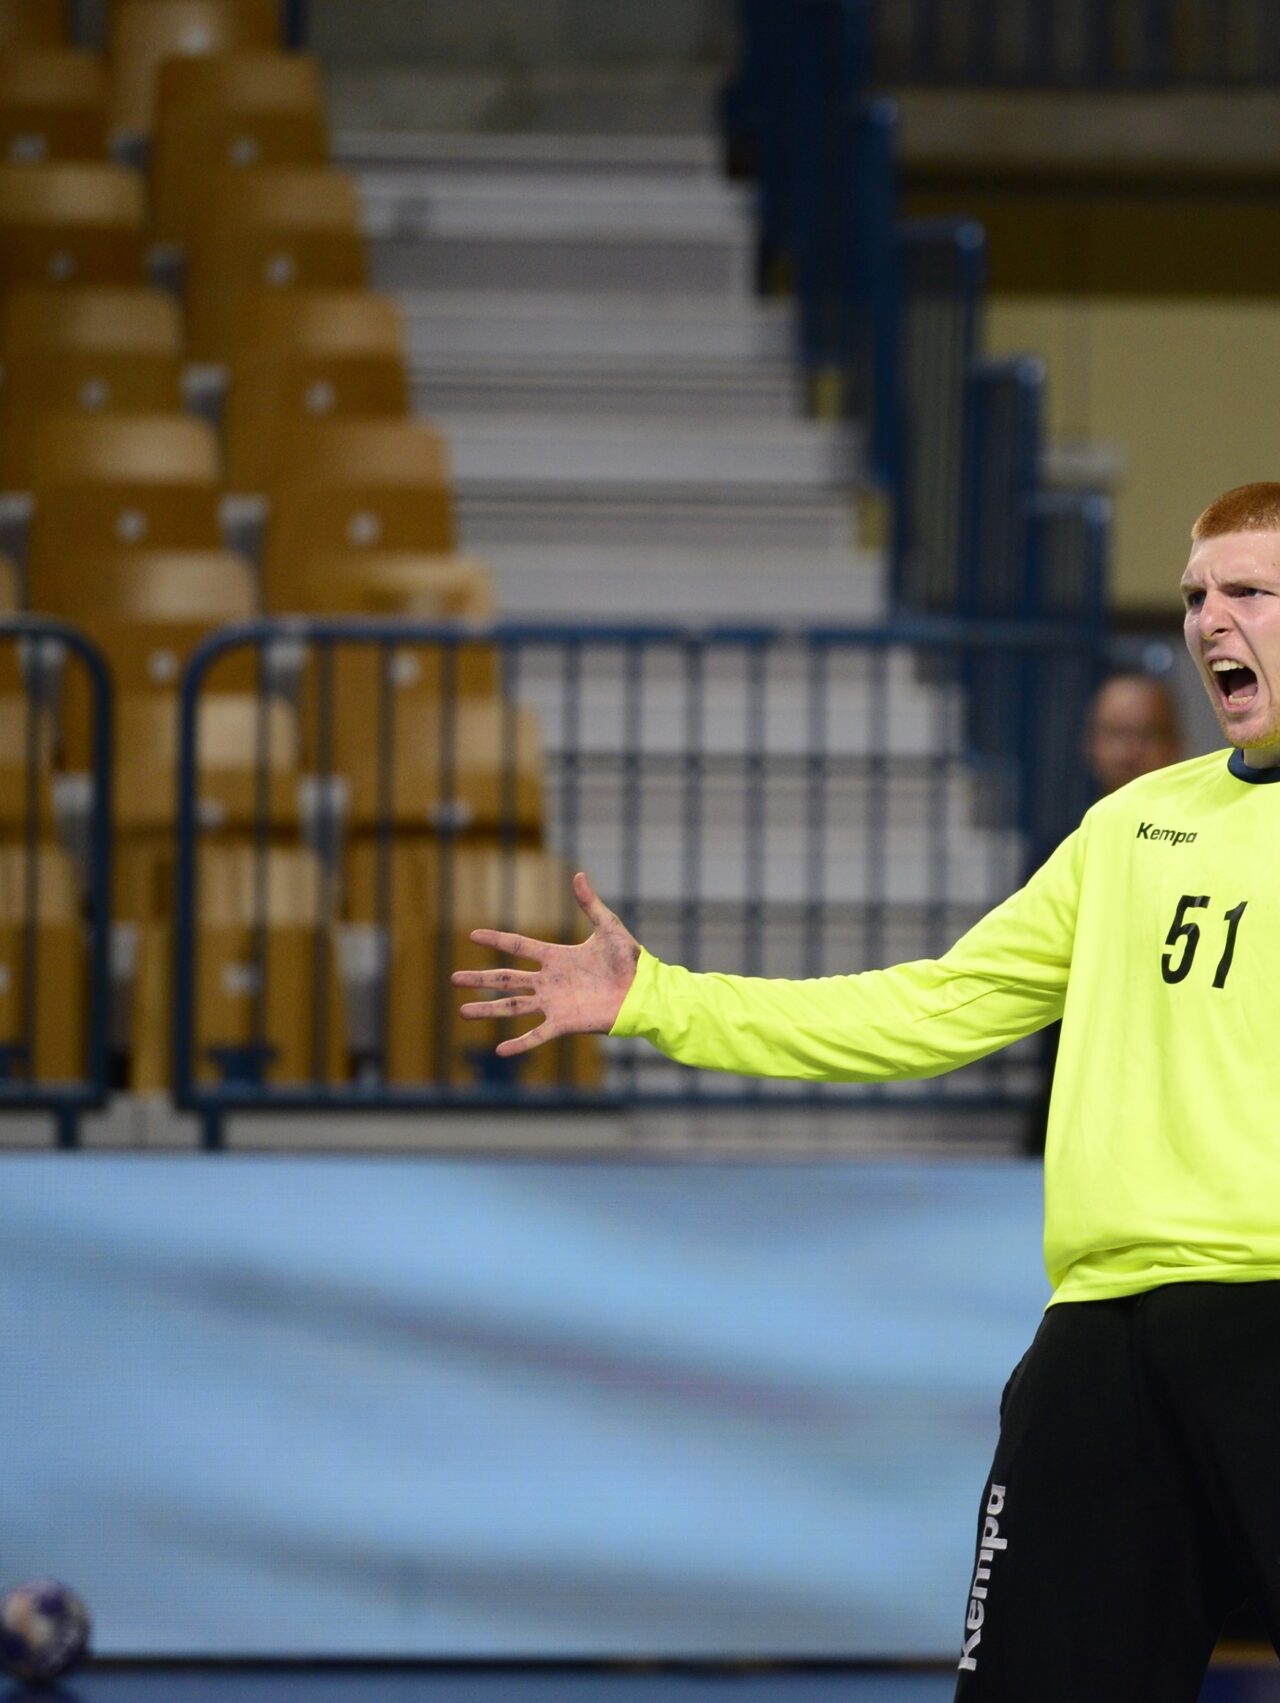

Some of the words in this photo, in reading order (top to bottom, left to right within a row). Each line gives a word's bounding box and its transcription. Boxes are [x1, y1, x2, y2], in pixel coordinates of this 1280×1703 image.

[1136, 822, 1198, 846] Kempa
[1161, 895, 1248, 989] 51
[957, 1483, 1008, 1671] Kempa
